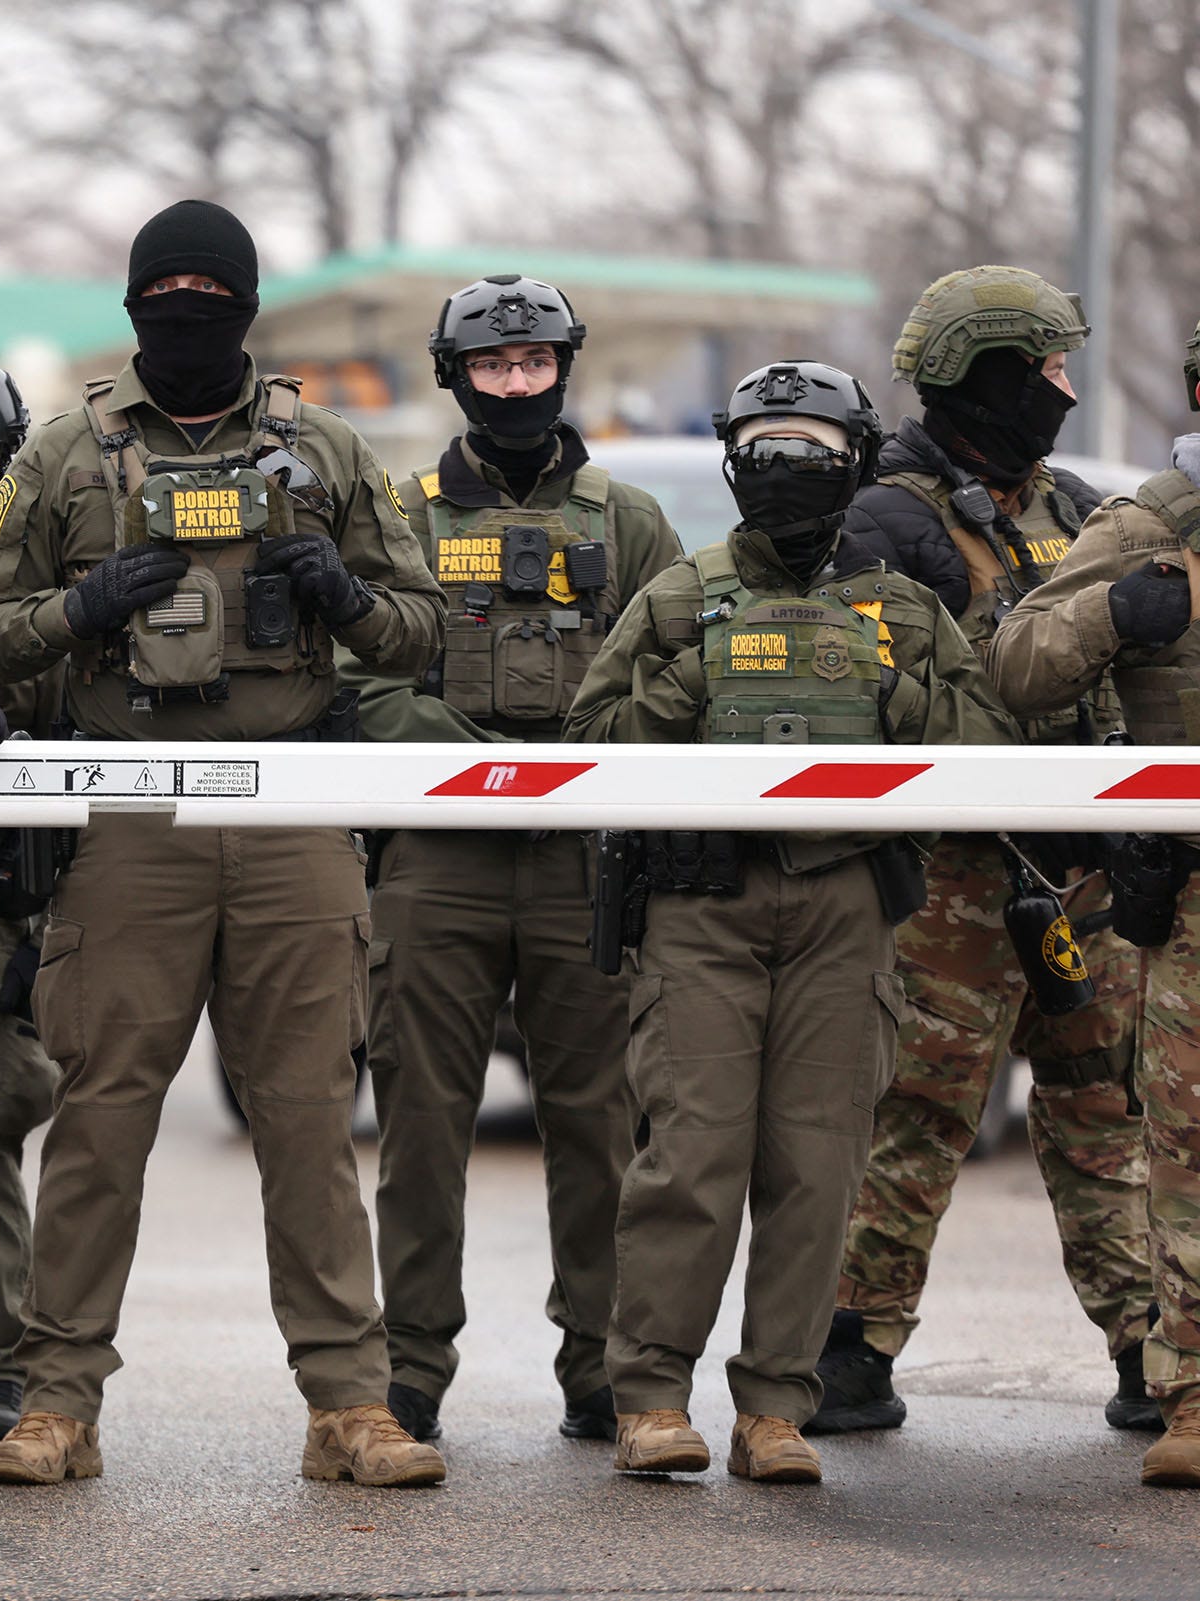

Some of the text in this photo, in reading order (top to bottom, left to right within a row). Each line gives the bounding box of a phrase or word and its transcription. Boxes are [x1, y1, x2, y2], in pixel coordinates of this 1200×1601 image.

[173, 491, 240, 509] BORDER
[175, 508, 242, 527] PATROL
[176, 526, 241, 537] FEDERAL AGENT
[439, 538, 502, 554] BORDER
[438, 555, 502, 572] PATROL
[438, 572, 502, 582] FEDERAL AGENT
[731, 634, 788, 656] BORDER PATROL
[732, 658, 786, 671] FEDERAL AGENT
